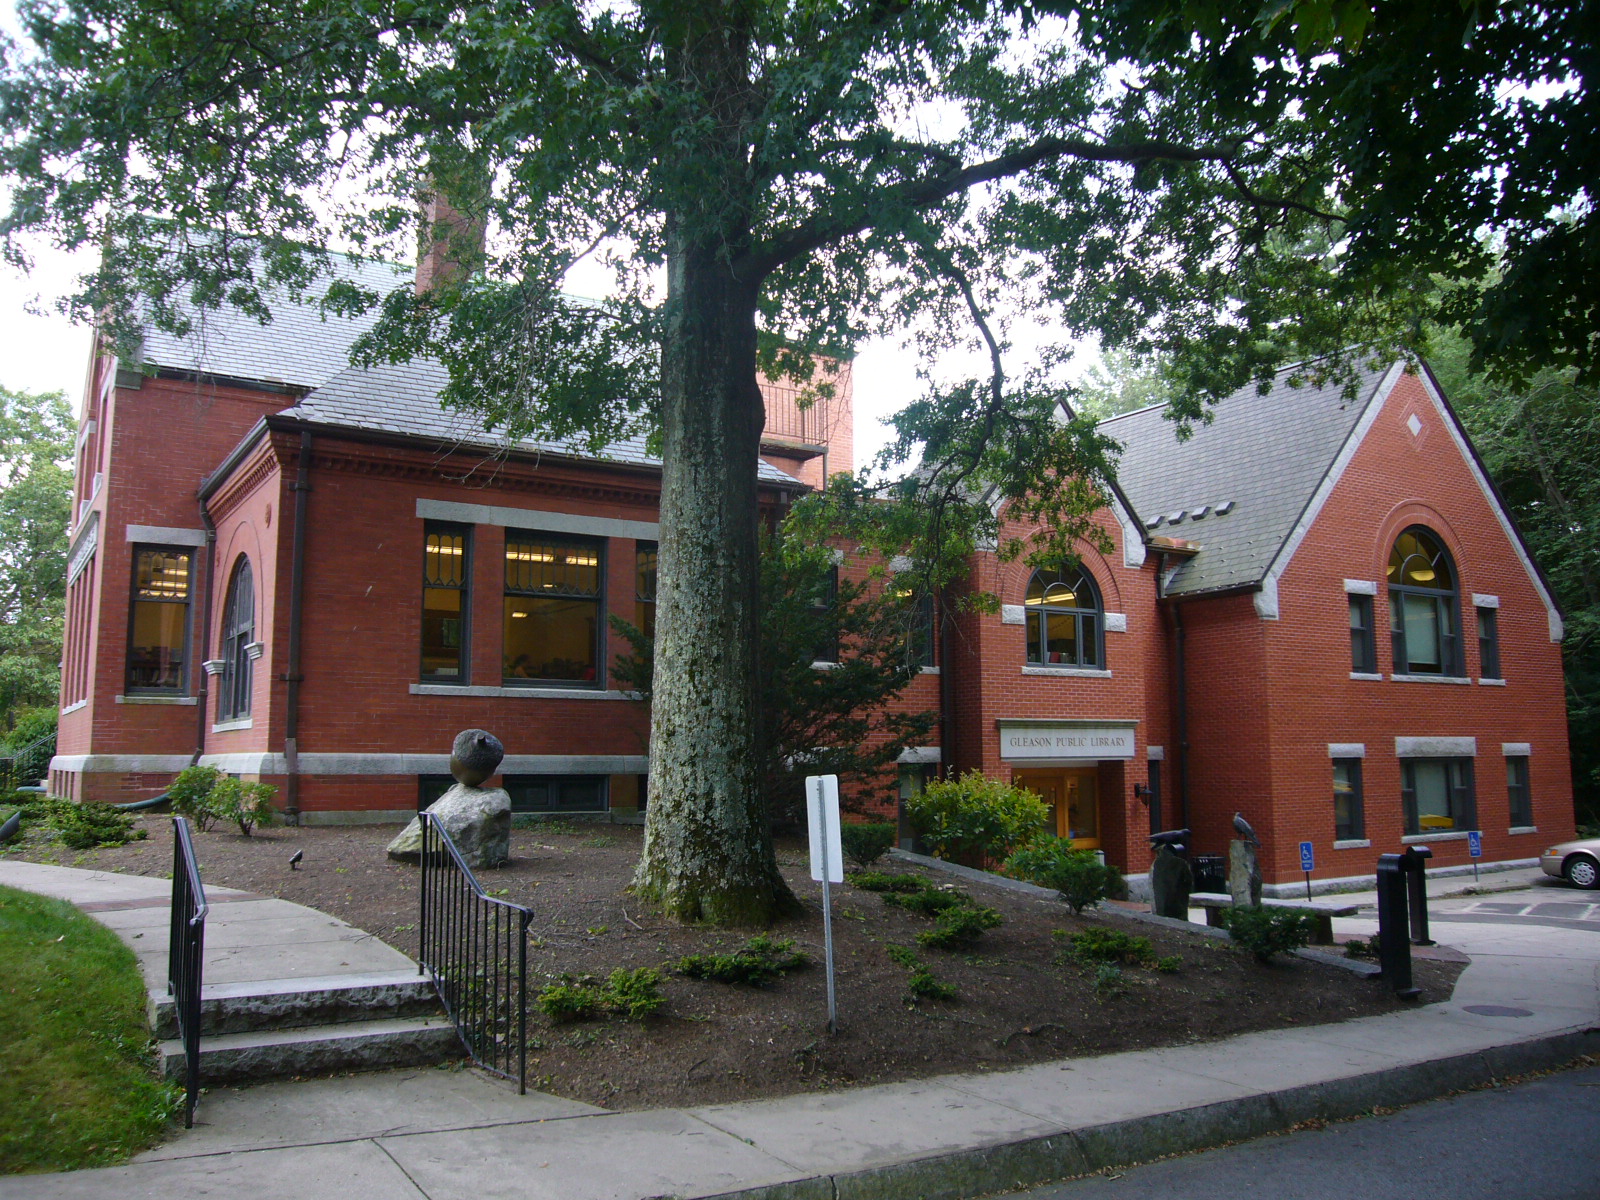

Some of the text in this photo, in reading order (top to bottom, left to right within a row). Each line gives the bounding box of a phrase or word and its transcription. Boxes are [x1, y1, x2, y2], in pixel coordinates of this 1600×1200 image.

[1010, 737, 1126, 747] GLEASON PUBLIC LIBRARY
